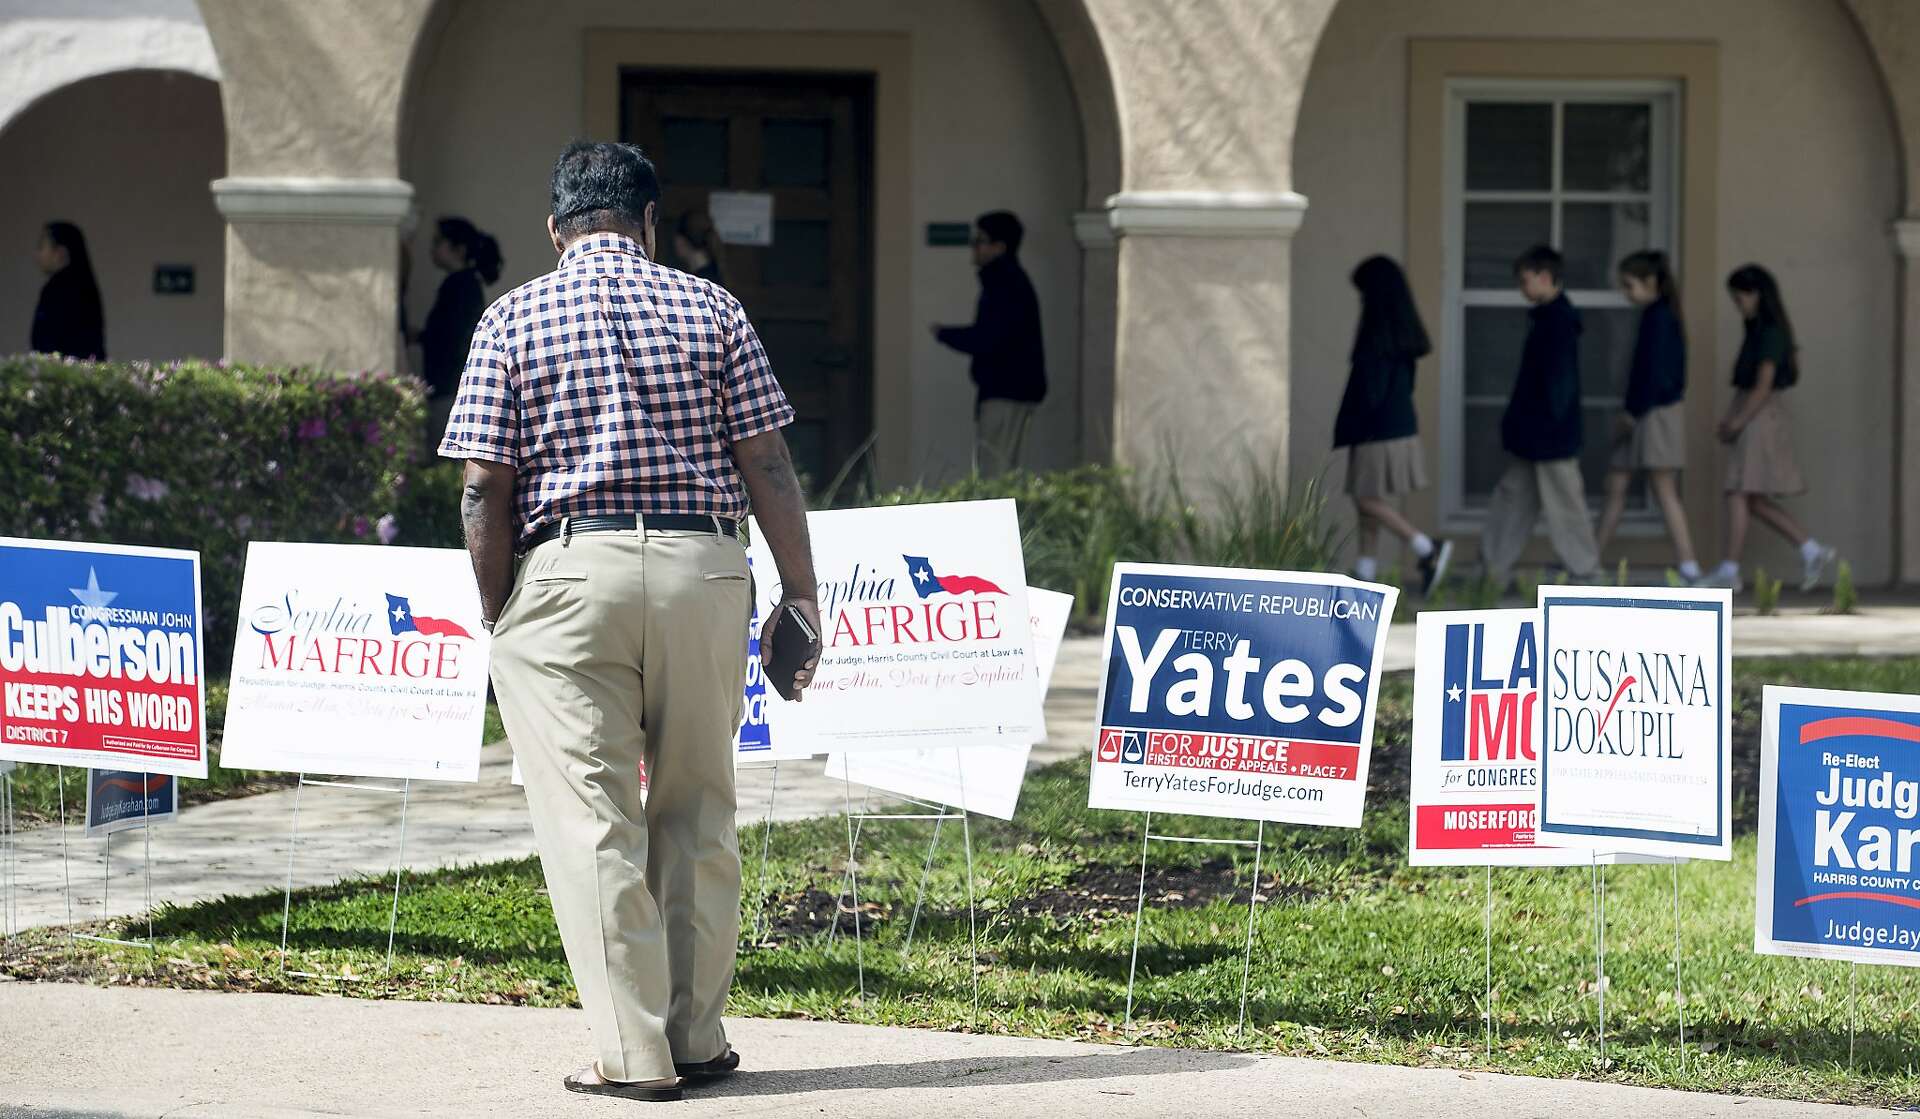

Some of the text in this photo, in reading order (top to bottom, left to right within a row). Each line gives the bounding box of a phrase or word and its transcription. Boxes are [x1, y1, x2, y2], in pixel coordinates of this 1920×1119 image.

[71, 605, 192, 628] CONGRESSMAN JOHN
[251, 588, 372, 648] Sophia
[1120, 587, 1377, 621] CONSERVATIVE REPUBLICAN
[815, 600, 1001, 648] AFRIGE
[0, 602, 196, 686] Culberson
[867, 654, 894, 664] Harris
[896, 652, 928, 663] County
[952, 649, 978, 660] Court
[980, 649, 989, 658] at
[991, 648, 1011, 658] Law
[1013, 647, 1024, 656] #4
[1181, 630, 1239, 651] TERRY
[258, 634, 462, 680] MAFRIGE
[409, 686, 433, 696] Court
[435, 688, 444, 696] at
[446, 688, 463, 697] Law
[960, 663, 1025, 689] Sophia!
[1116, 625, 1366, 727] Yates
[1553, 648, 1712, 707] SUSANNA
[5, 682, 193, 733] KEEPS HIS WORD
[6, 725, 69, 744] DISTRICT 7
[1150, 733, 1290, 761] FOR JUSTICE
[1553, 706, 1684, 759] DOKUPIL
[1147, 754, 1348, 778] FIRST COURT OF APPEALS PLACE 7
[1822, 752, 1880, 769] Re-Elect
[1123, 770, 1324, 802] TerryYatesForJudge.com
[1441, 770, 1463, 788] for
[1816, 768, 1919, 819] Judg
[1814, 872, 1857, 886] HARRIS
[1860, 875, 1910, 890] COUNTY
[1824, 919, 1920, 950] JudgeJay
